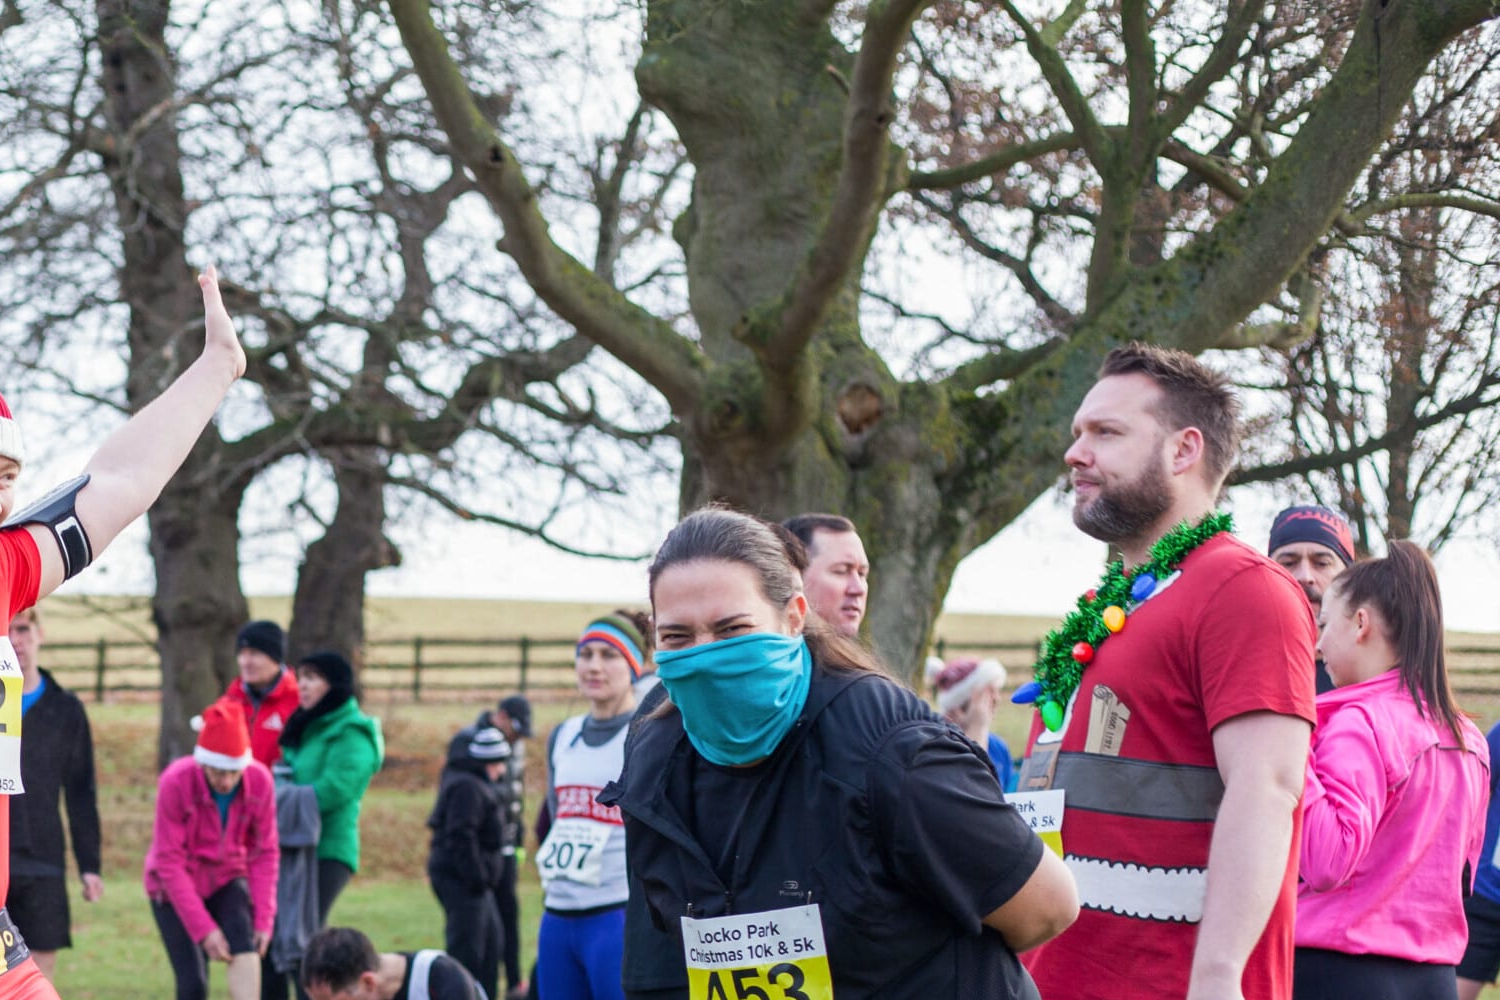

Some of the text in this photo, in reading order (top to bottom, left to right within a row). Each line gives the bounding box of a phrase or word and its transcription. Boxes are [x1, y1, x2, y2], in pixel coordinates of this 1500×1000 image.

[1041, 815, 1056, 827] 5k
[543, 842, 593, 870] 207
[698, 921, 781, 943] Locko Park
[690, 937, 816, 963] Christmas 10k & 5k
